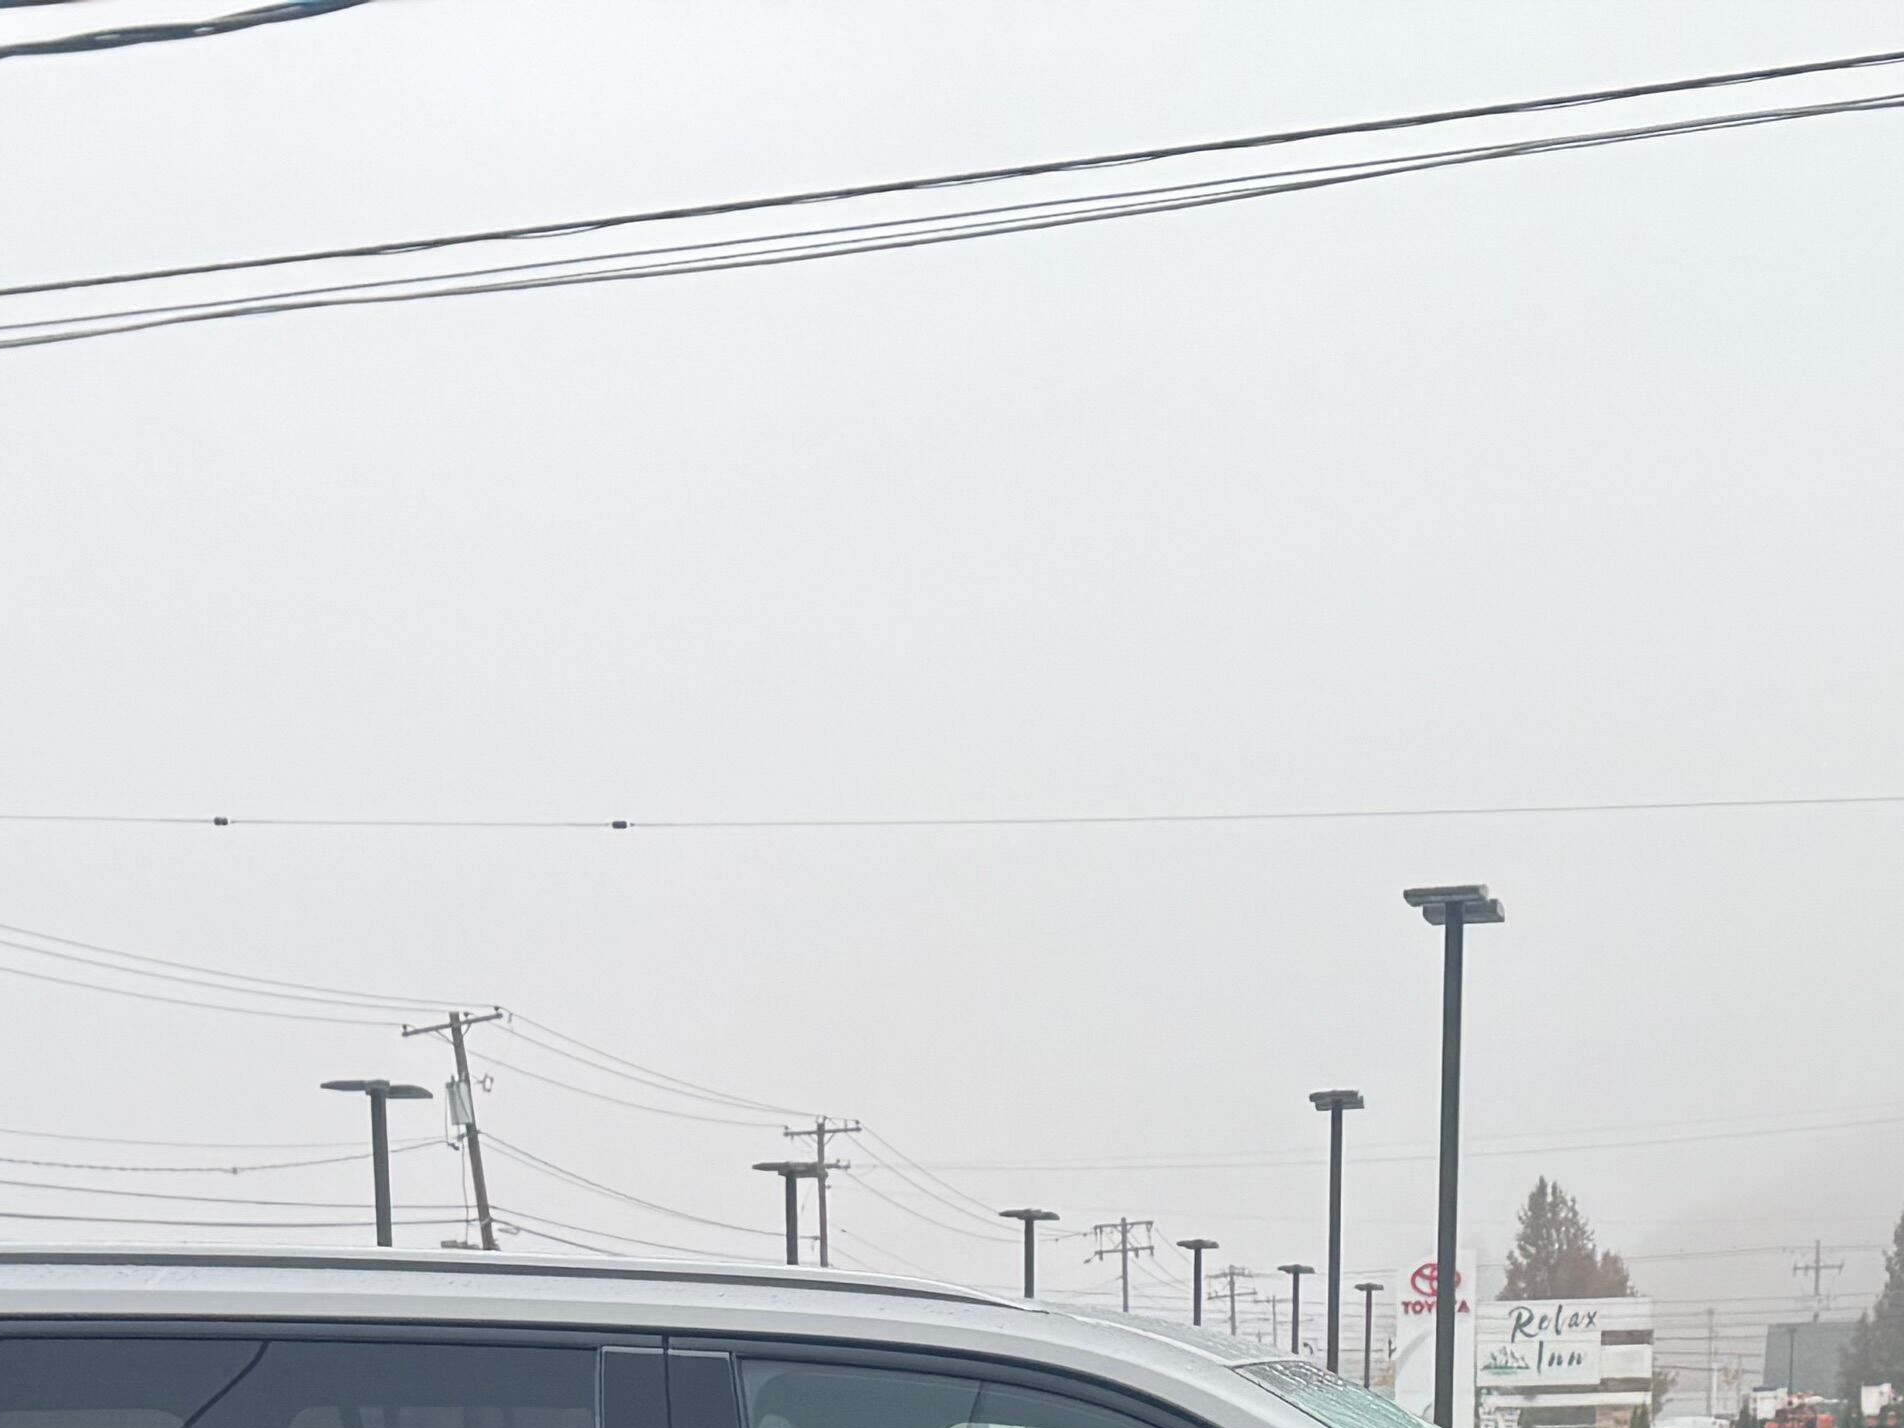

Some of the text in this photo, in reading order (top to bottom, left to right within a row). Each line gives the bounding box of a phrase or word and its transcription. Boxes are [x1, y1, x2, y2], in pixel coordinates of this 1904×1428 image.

[1401, 1300, 1470, 1315] TOYA
[1508, 1304, 1597, 1343] Relax
[1536, 1340, 1583, 1374] Inn
